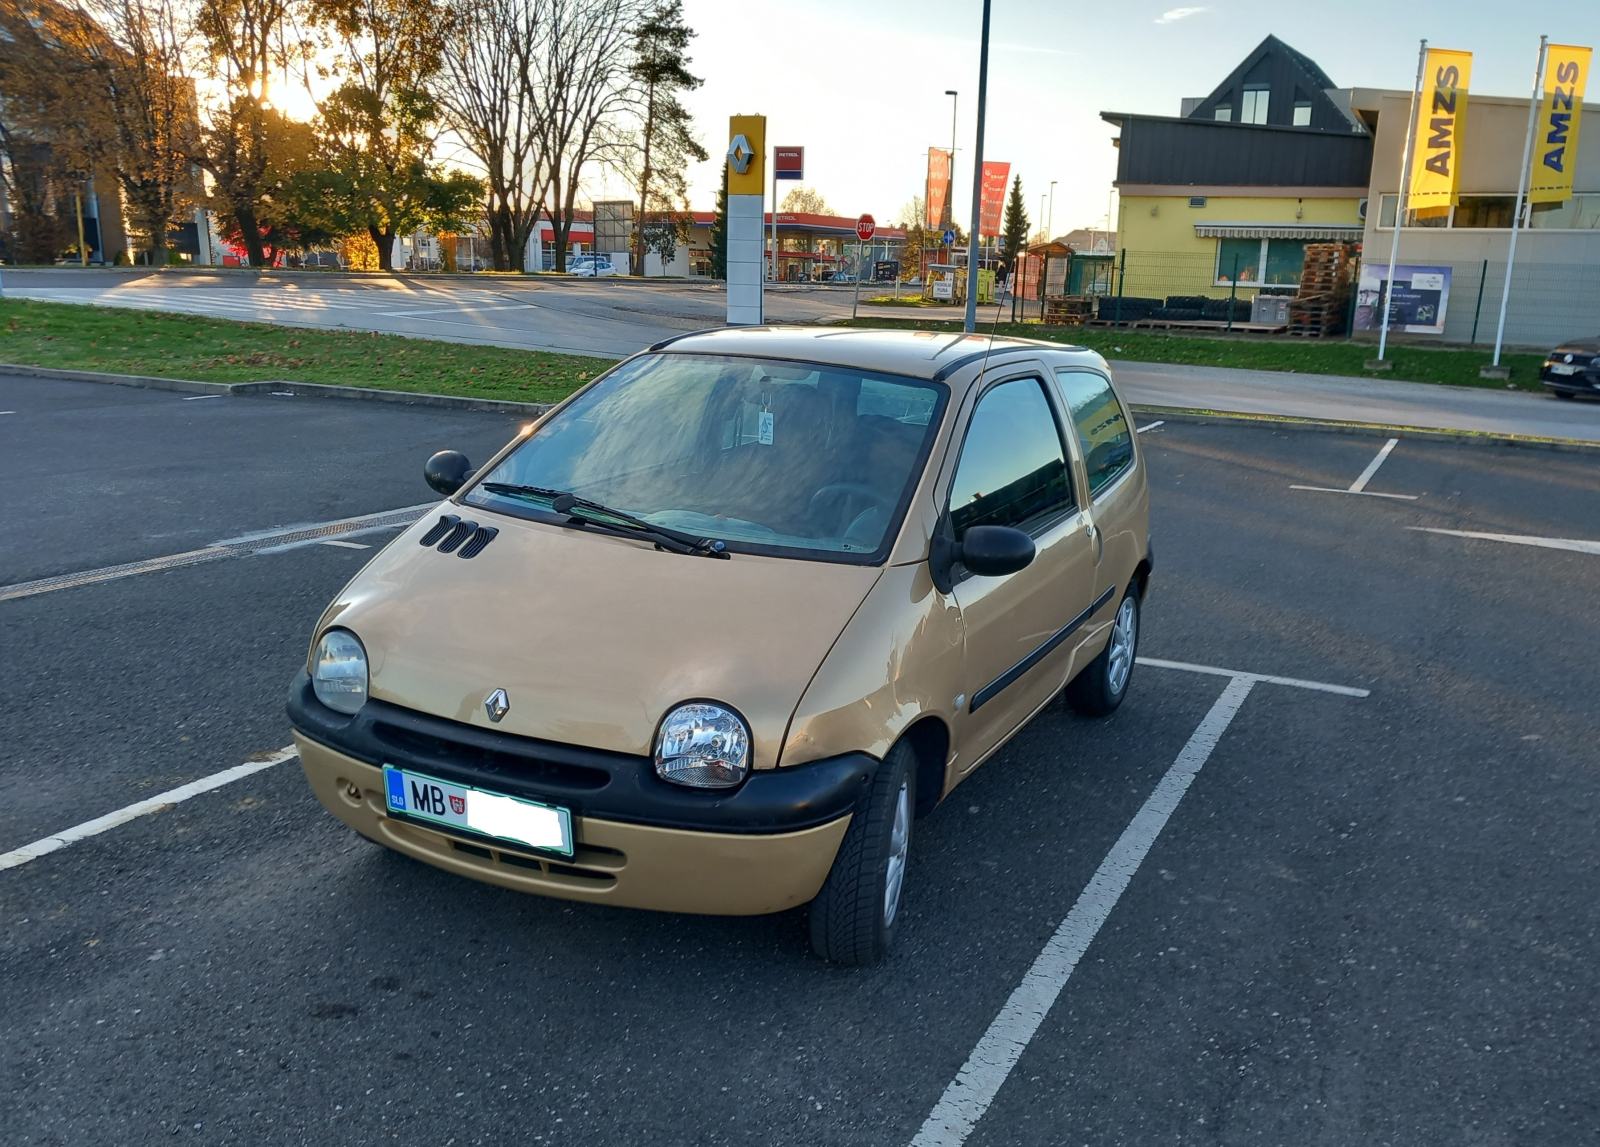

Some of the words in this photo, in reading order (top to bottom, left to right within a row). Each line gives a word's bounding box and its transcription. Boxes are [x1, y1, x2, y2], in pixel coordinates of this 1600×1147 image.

[1425, 65, 1459, 178] AMZS
[1543, 61, 1579, 173] AMZS
[858, 222, 875, 233] STOP
[391, 794, 404, 807] SLO
[411, 780, 446, 816] MB
